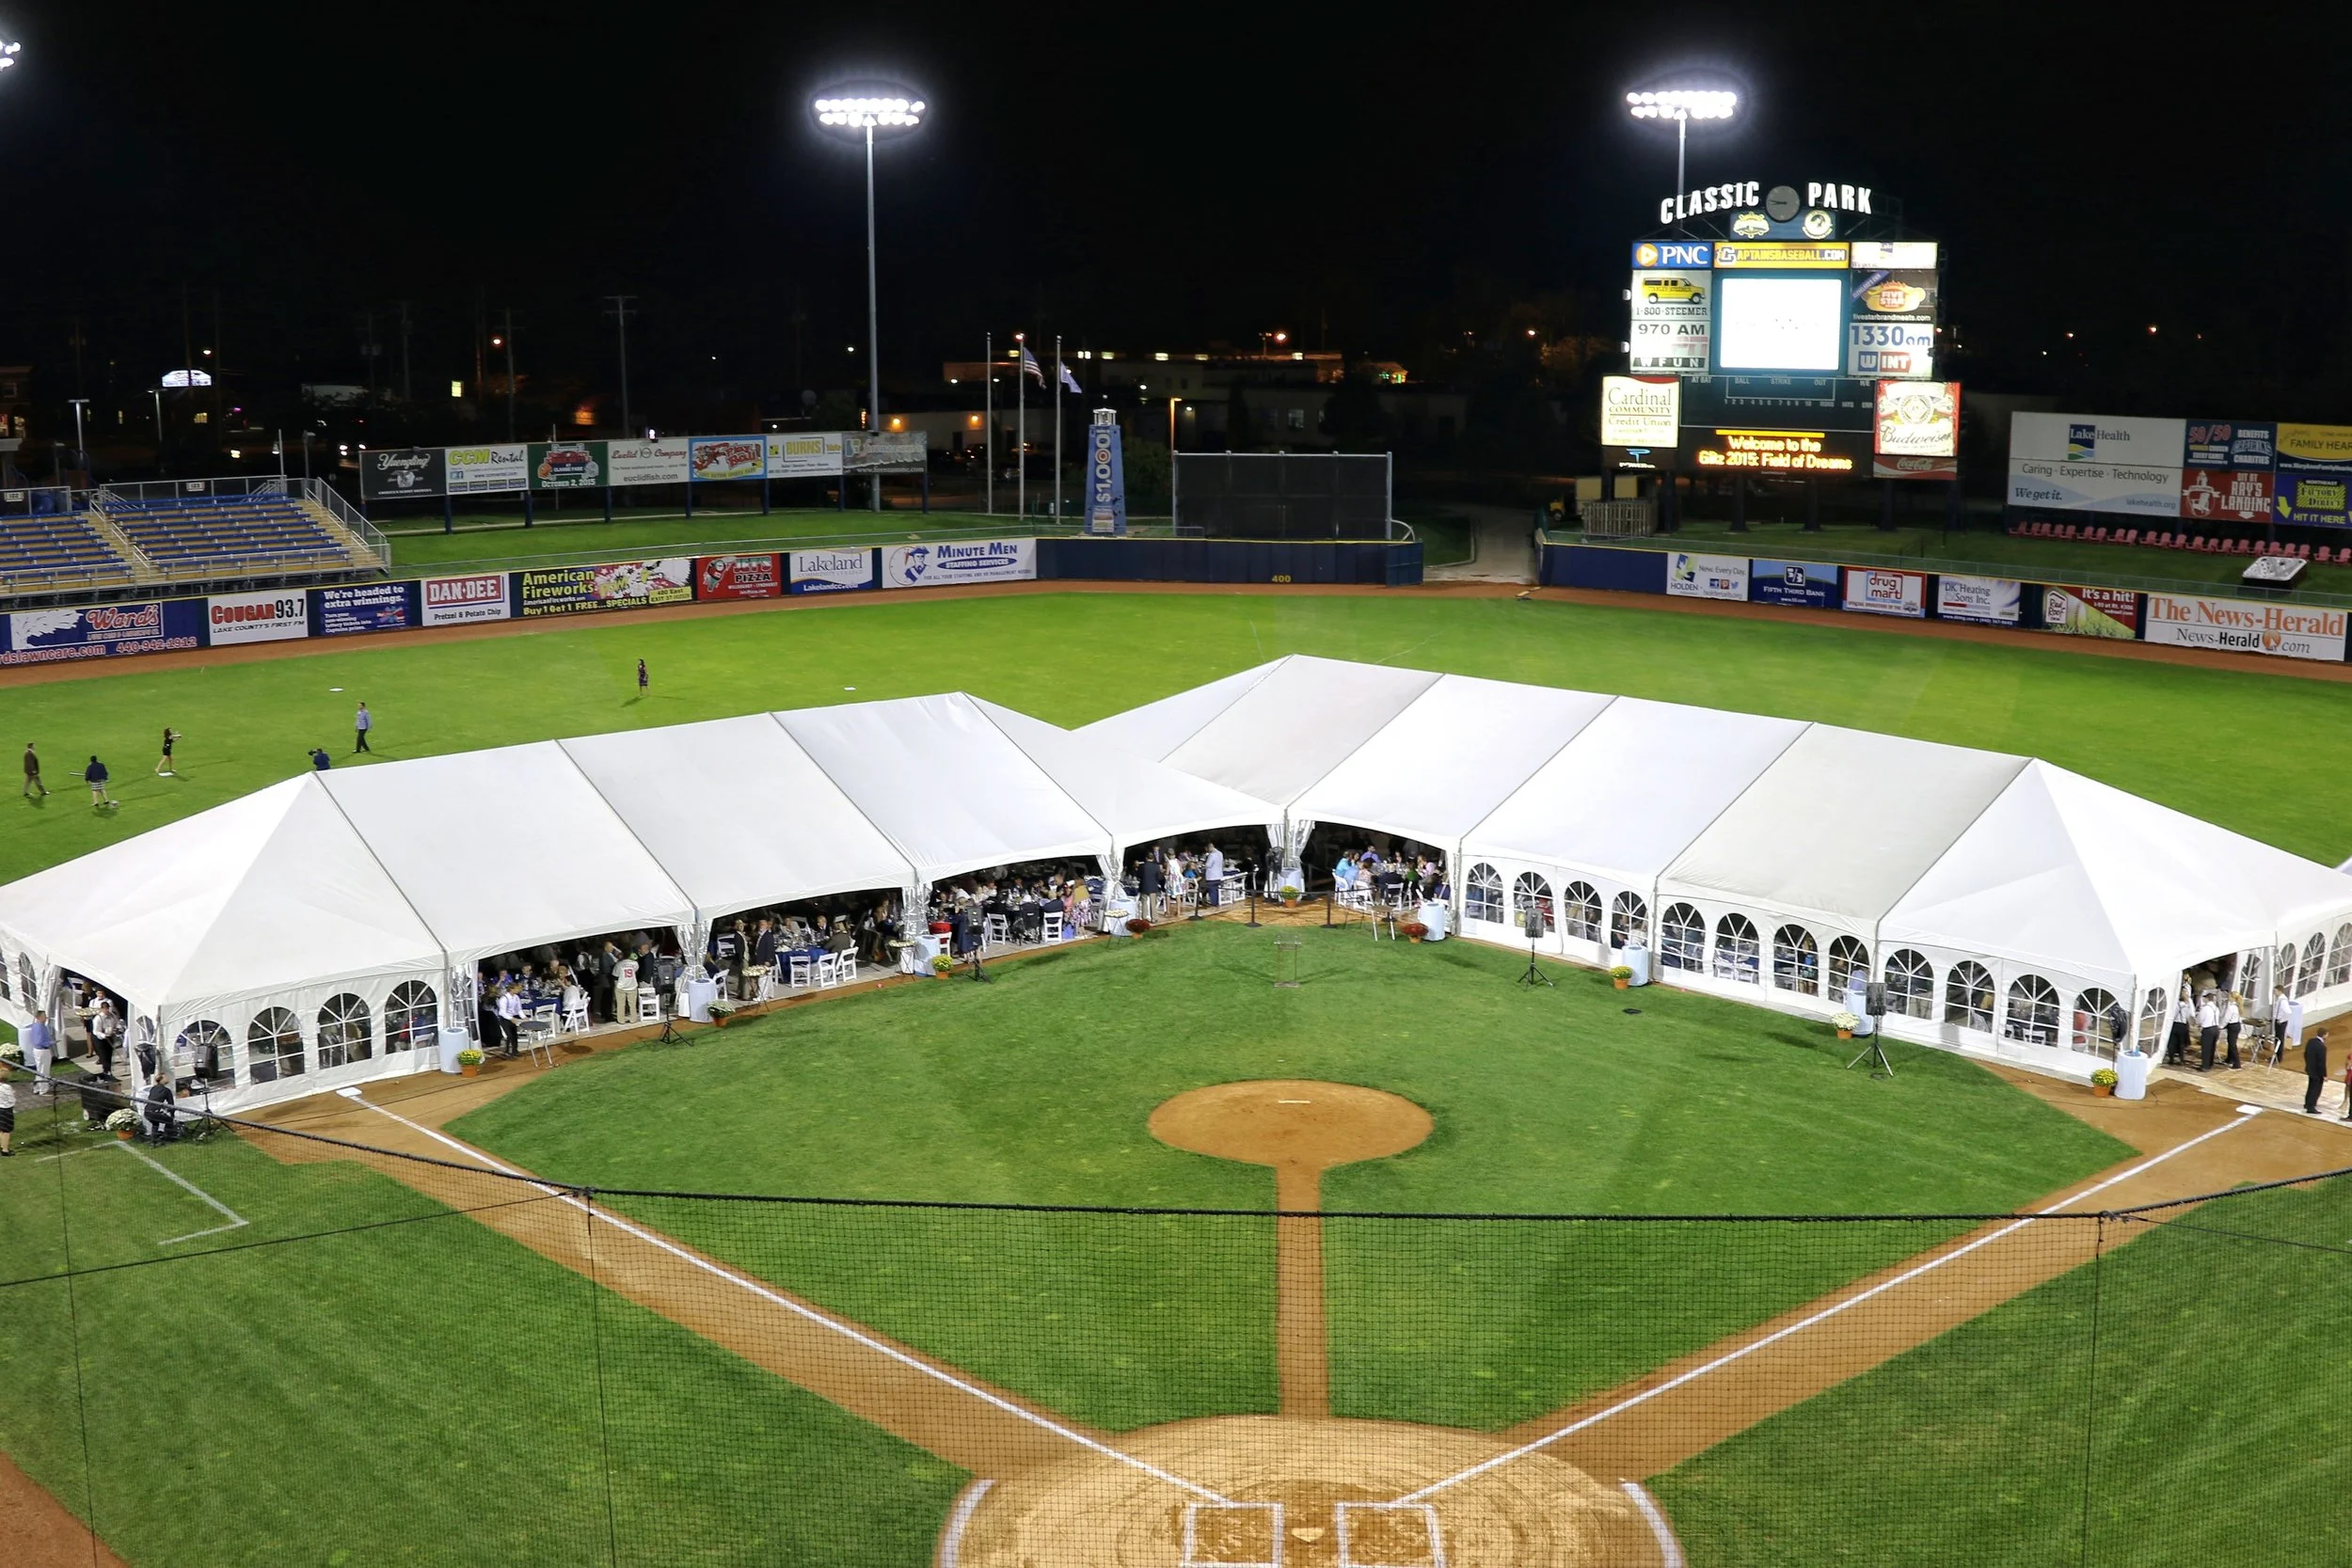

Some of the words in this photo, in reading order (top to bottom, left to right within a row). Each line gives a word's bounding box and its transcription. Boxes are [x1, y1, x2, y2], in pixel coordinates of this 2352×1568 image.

[1661, 181, 1759, 225] CLASSIC
[1808, 182, 1872, 214] PARK
[1661, 245, 1708, 264] PNC
[1638, 323, 1670, 335] 970
[1677, 324, 1705, 335] AM
[1608, 387, 1672, 405] Cardinal
[1608, 417, 1640, 426] Credit
[1643, 417, 1672, 426] Union
[1880, 424, 1952, 444] Budweiser
[2070, 428, 2095, 440] Lake
[2096, 429, 2131, 441] Health
[786, 440, 822, 456] BURNS
[1727, 436, 1785, 451] Welcome
[1786, 438, 1800, 451] to
[1800, 437, 1821, 452] the
[2290, 438, 2326, 450] FAMILY
[376, 452, 431, 471] Yuengling
[450, 449, 490, 467] CCM
[490, 450, 524, 465] Rental
[611, 450, 638, 459] Euclid
[654, 449, 687, 459] Company
[1761, 451, 1790, 467] Field
[1791, 453, 1805, 467] of
[1805, 453, 1853, 469] Dreams
[623, 474, 678, 483] euclidfish.com
[2022, 464, 2053, 477] Caring
[2059, 466, 2105, 479] Expertise
[2112, 468, 2169, 484] Technology
[2015, 487, 2033, 499] We
[2033, 490, 2051, 501] get
[2050, 490, 2063, 501] it.
[2231, 481, 2263, 498] RAY'S
[2125, 498, 2176, 510] lakehealth.org
[2220, 495, 2271, 514] LANDING
[2293, 513, 2309, 521] HIT
[2310, 514, 2320, 522] IT
[2320, 515, 2346, 525] HERE
[937, 546, 986, 559] MINUTE
[989, 542, 1018, 556] MEN
[799, 552, 863, 573] Lakeland
[946, 560, 977, 569] STAFFING
[978, 558, 1009, 566] SERVICES
[522, 570, 596, 586] American
[735, 573, 771, 582] PIZZA
[1715, 566, 1733, 576] Every
[1272, 575, 1291, 583] 400
[1671, 582, 1698, 591] HOLDEN
[1868, 572, 1898, 591] drug
[324, 590, 354, 601] We're
[355, 586, 392, 598] headed
[392, 585, 405, 594] to
[522, 583, 594, 598] Fireworks
[1784, 587, 1805, 595] THIRD
[1805, 589, 1826, 597] BANK
[1871, 588, 1900, 600] mart
[1945, 582, 1958, 593] DK
[1960, 584, 1992, 596] Heating
[2082, 588, 2101, 600] It's
[2102, 592, 2110, 600] a
[2112, 590, 2136, 603] hit!
[324, 600, 352, 610] extra
[353, 594, 405, 607] winnings.
[1955, 593, 1975, 604] Sons
[1976, 595, 1991, 605] Inc.
[2049, 598, 2063, 609] Red
[211, 603, 276, 626] COUGAR
[275, 598, 306, 620] 93.7
[435, 612, 458, 621] Pretzel
[465, 610, 486, 619] Potato
[486, 608, 502, 618] Chip
[523, 606, 542, 615] Buy
[549, 604, 566, 613] Get
[2048, 606, 2066, 619] Roof
[2149, 597, 2191, 621] The
[2196, 600, 2345, 637] News-Herald
[87, 605, 159, 630] Ward's
[235, 624, 270, 632] COUNTY'S
[116, 636, 198, 653] 440-942-1912
[2176, 627, 2260, 649] News-Herald
[2281, 641, 2311, 654] com
